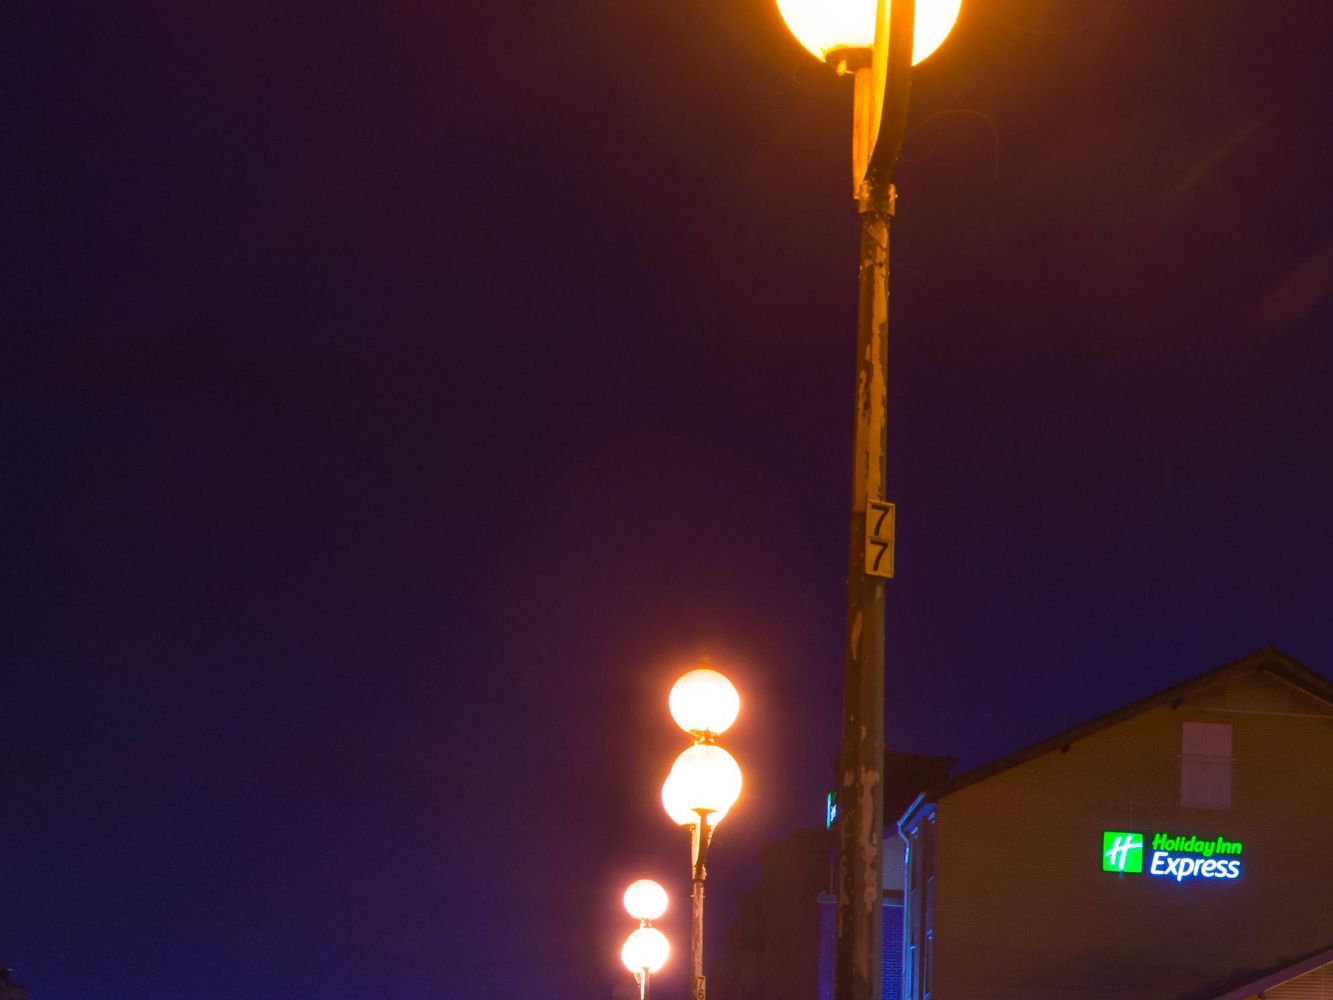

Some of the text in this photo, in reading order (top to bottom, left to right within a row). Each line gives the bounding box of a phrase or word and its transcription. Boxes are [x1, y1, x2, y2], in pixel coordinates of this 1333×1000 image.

[870, 504, 890, 572] 77
[1152, 833, 1243, 857] Holiday Inn
[1150, 851, 1241, 882] Express
[698, 976, 705, 1000] 76
